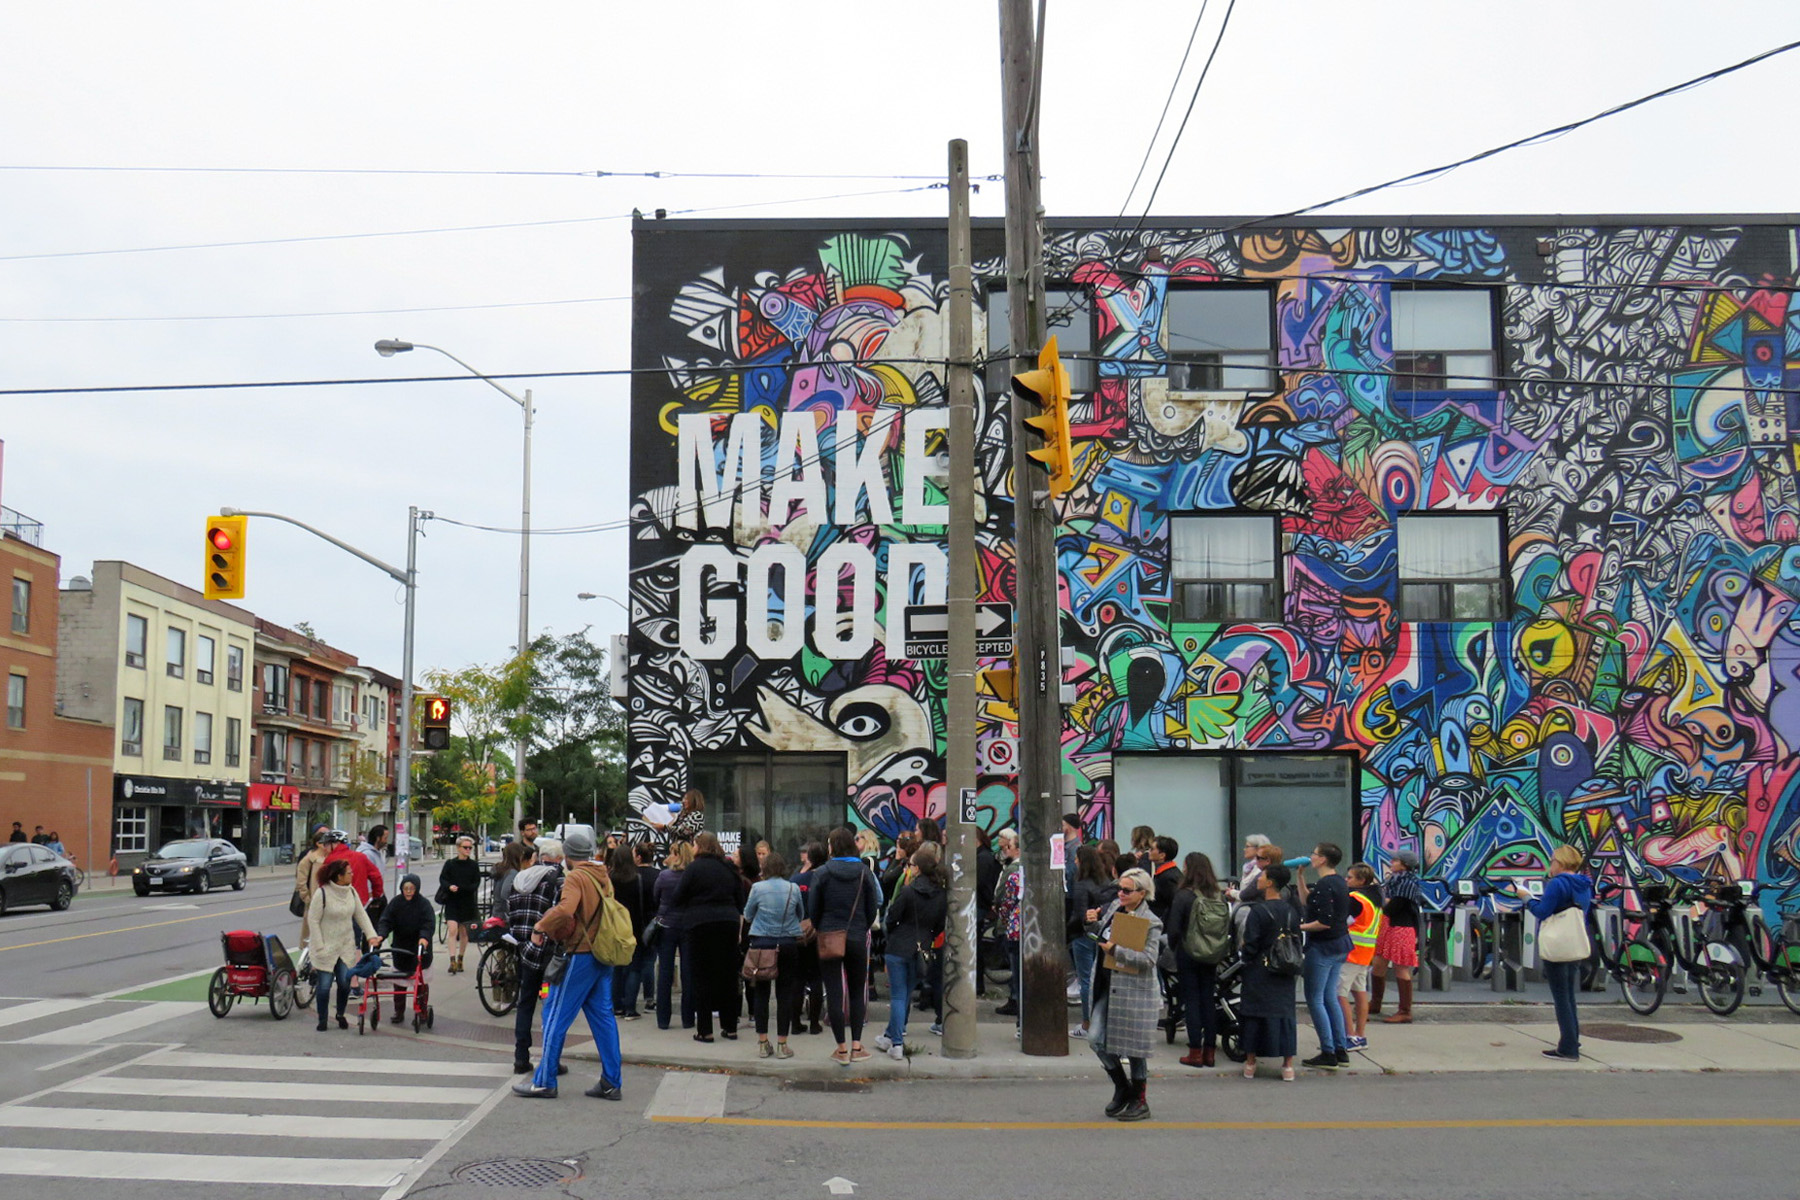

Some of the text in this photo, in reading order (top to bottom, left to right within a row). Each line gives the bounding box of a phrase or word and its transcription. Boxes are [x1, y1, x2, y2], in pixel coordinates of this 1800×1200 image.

[676, 409, 950, 525] MAKE
[906, 644, 948, 656] BICYCLE
[717, 832, 741, 842] MAKE
